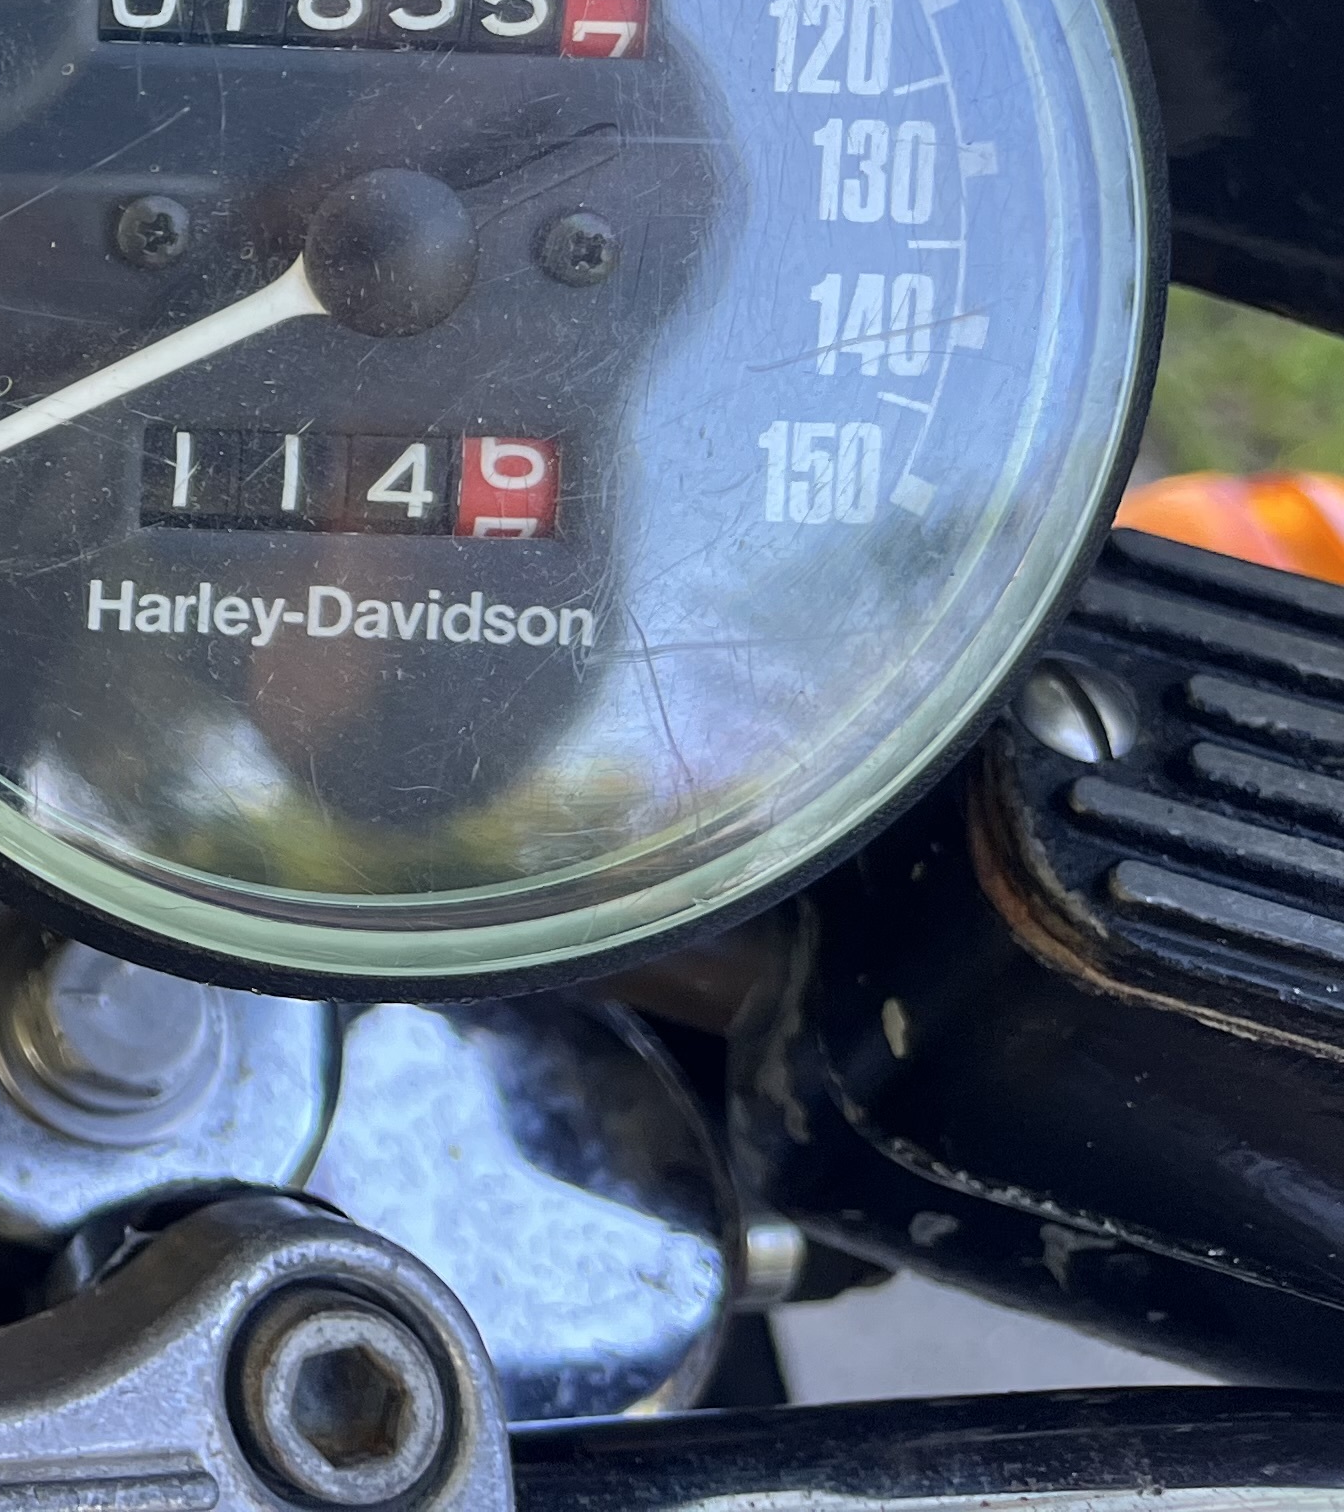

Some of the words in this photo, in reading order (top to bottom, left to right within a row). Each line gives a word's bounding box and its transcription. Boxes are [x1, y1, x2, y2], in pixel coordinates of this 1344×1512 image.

[813, 118, 936, 224] 130
[811, 273, 935, 376] 140
[758, 420, 883, 524] 150
[87, 578, 596, 648] Harley-Davidson
